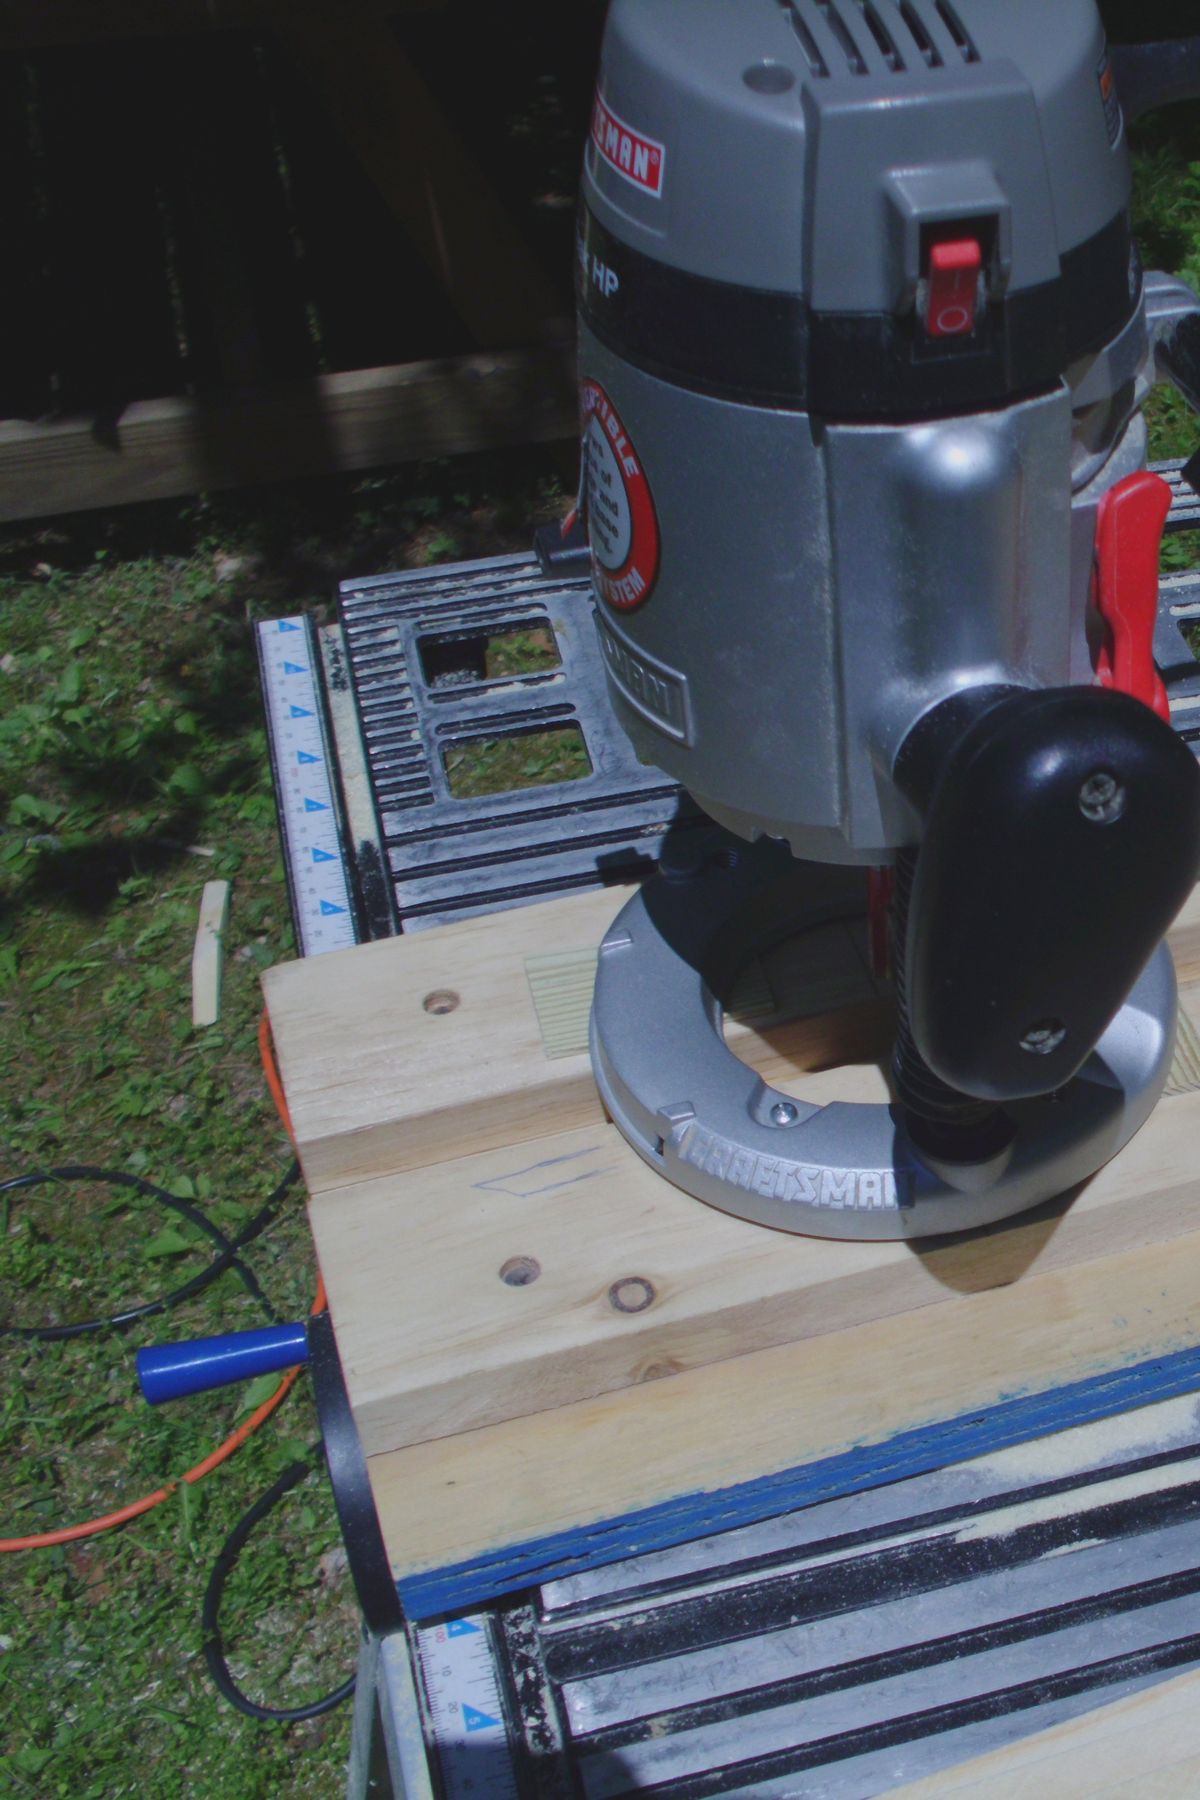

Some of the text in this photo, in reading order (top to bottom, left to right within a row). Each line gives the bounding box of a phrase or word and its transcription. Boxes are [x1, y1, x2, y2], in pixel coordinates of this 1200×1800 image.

[592, 255, 619, 297] HP
[679, 1126, 915, 1210] CRAFTSMAN
[442, 1665, 452, 1677] 10
